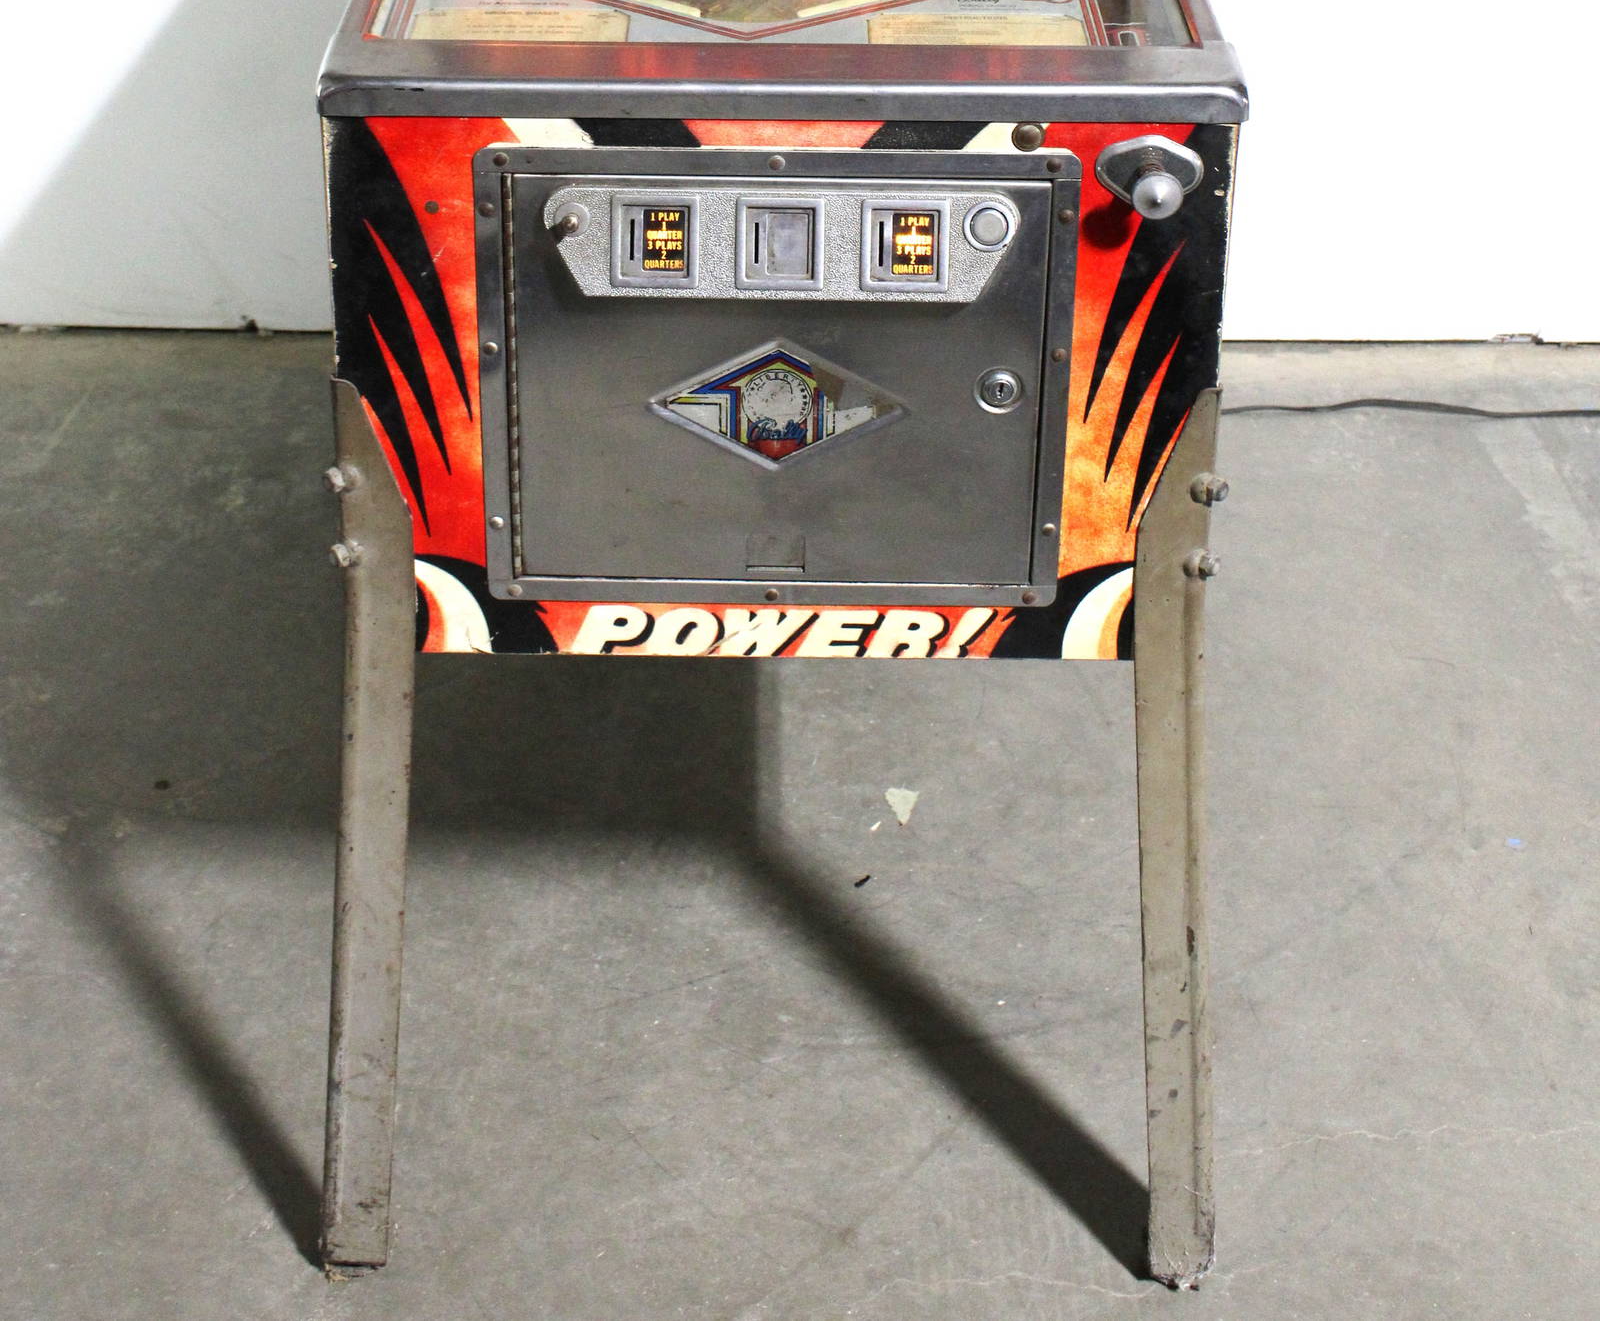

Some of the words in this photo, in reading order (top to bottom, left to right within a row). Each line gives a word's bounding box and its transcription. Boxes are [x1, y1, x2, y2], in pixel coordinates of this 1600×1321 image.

[651, 212, 655, 221] 1
[658, 212, 680, 221] PLAY
[662, 221, 667, 231] 1
[900, 217, 905, 226] 1
[908, 217, 930, 226] PLAY
[647, 241, 653, 250] 3
[655, 241, 682, 250] PLAYS
[896, 246, 902, 255] 3
[904, 245, 931, 255] PLAYS
[661, 251, 667, 259] 2
[910, 255, 916, 264] 2
[644, 259, 684, 269] QUARTERS
[893, 264, 933, 275] QUARTERS
[570, 604, 998, 658] POWER!
